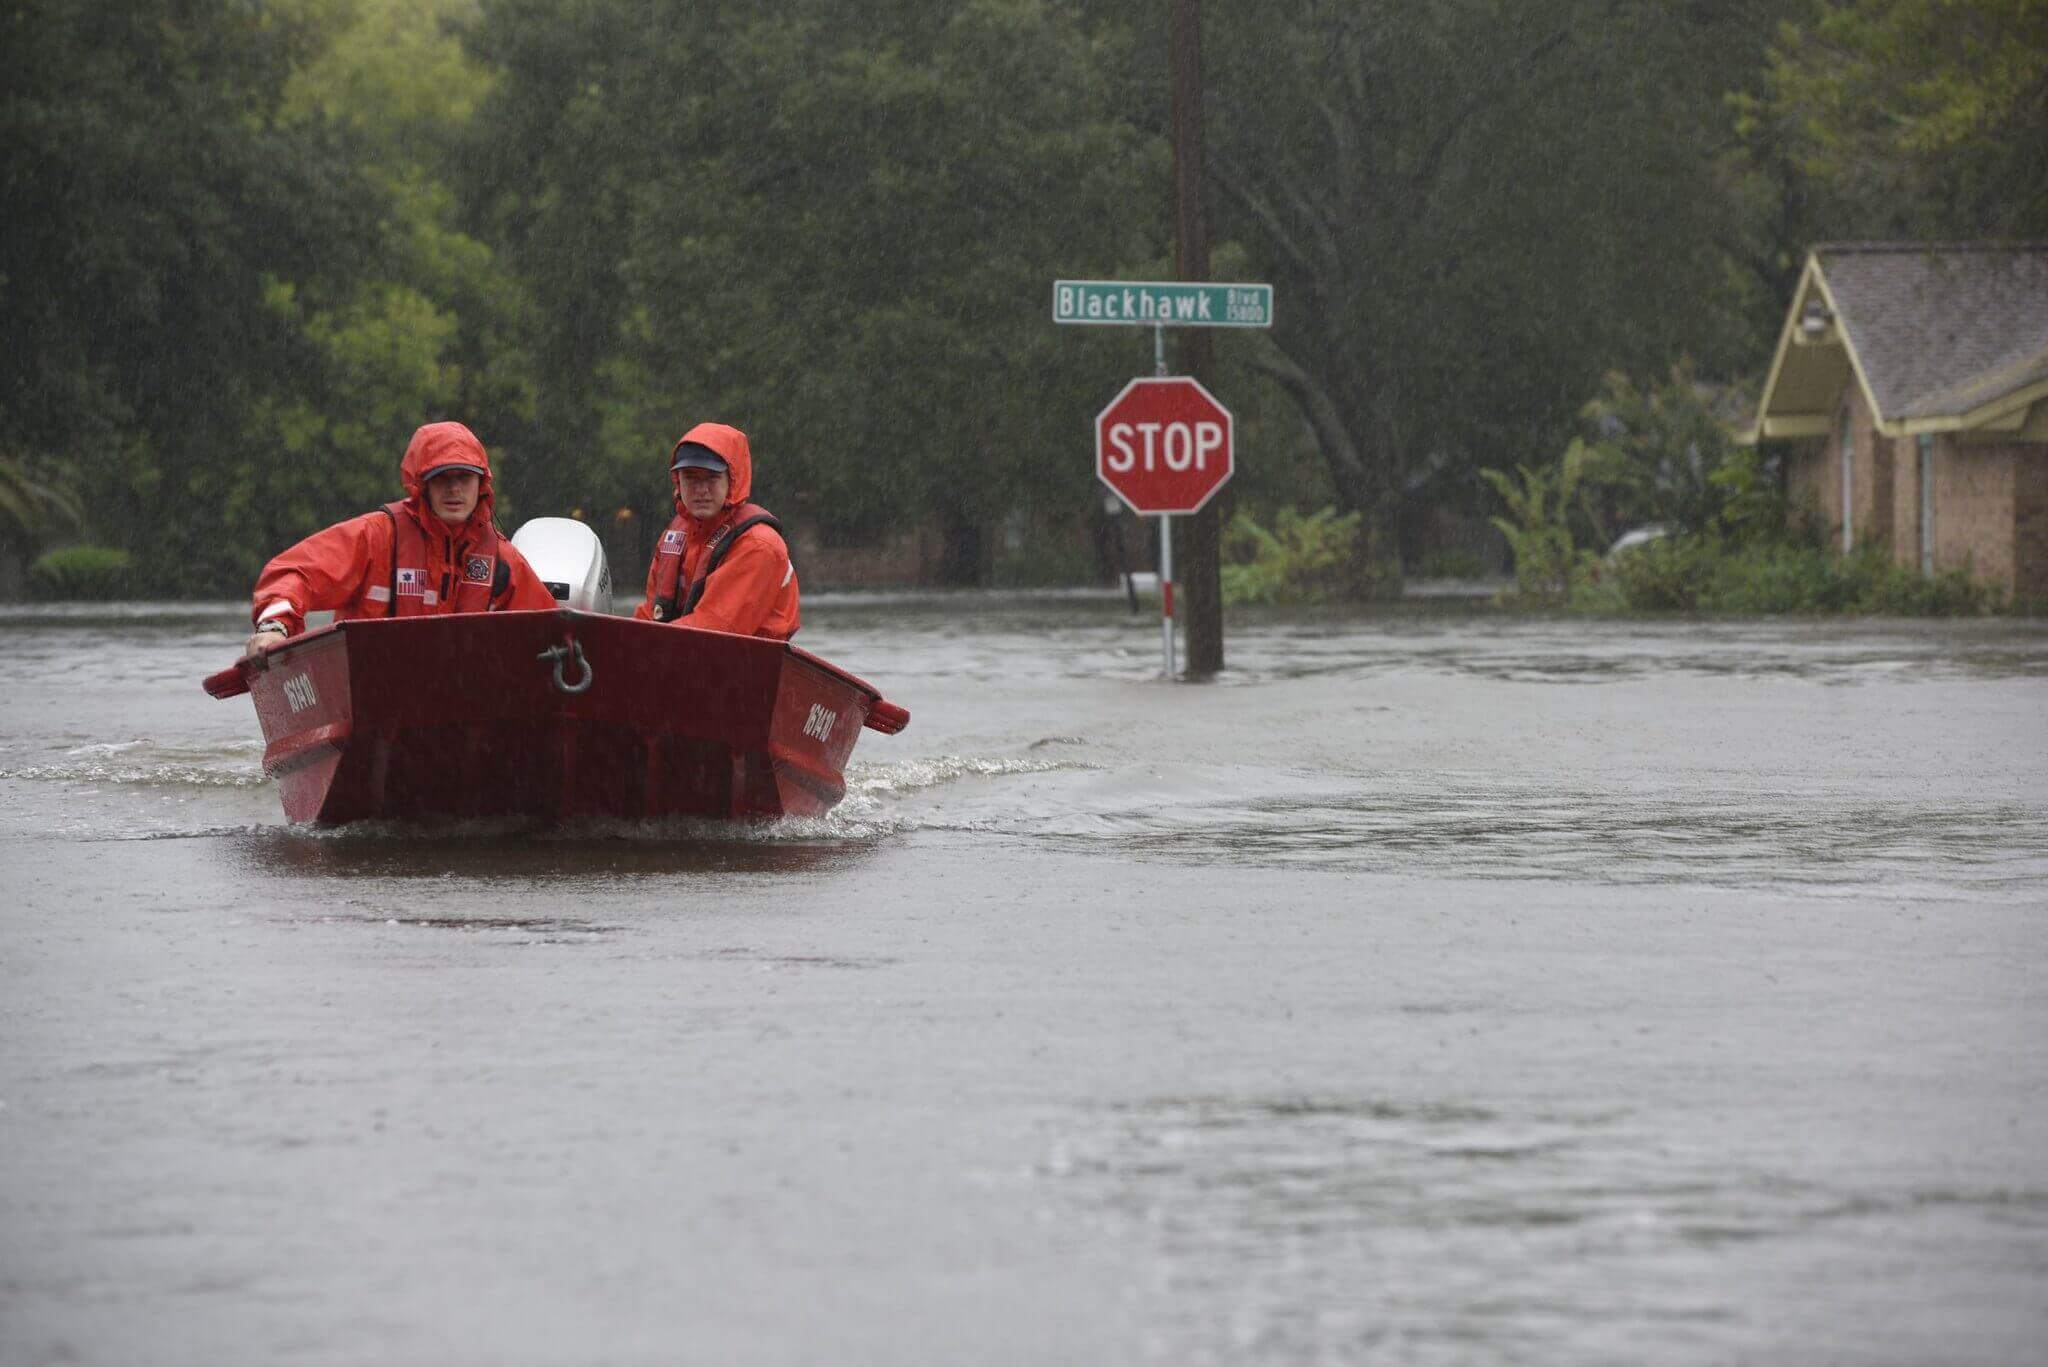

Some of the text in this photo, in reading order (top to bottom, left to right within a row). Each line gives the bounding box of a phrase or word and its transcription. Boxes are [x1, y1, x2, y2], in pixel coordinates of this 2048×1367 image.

[1059, 286, 1211, 319] Blackhawk
[1227, 288, 1259, 305] Blvd
[1107, 421, 1223, 472] STOP
